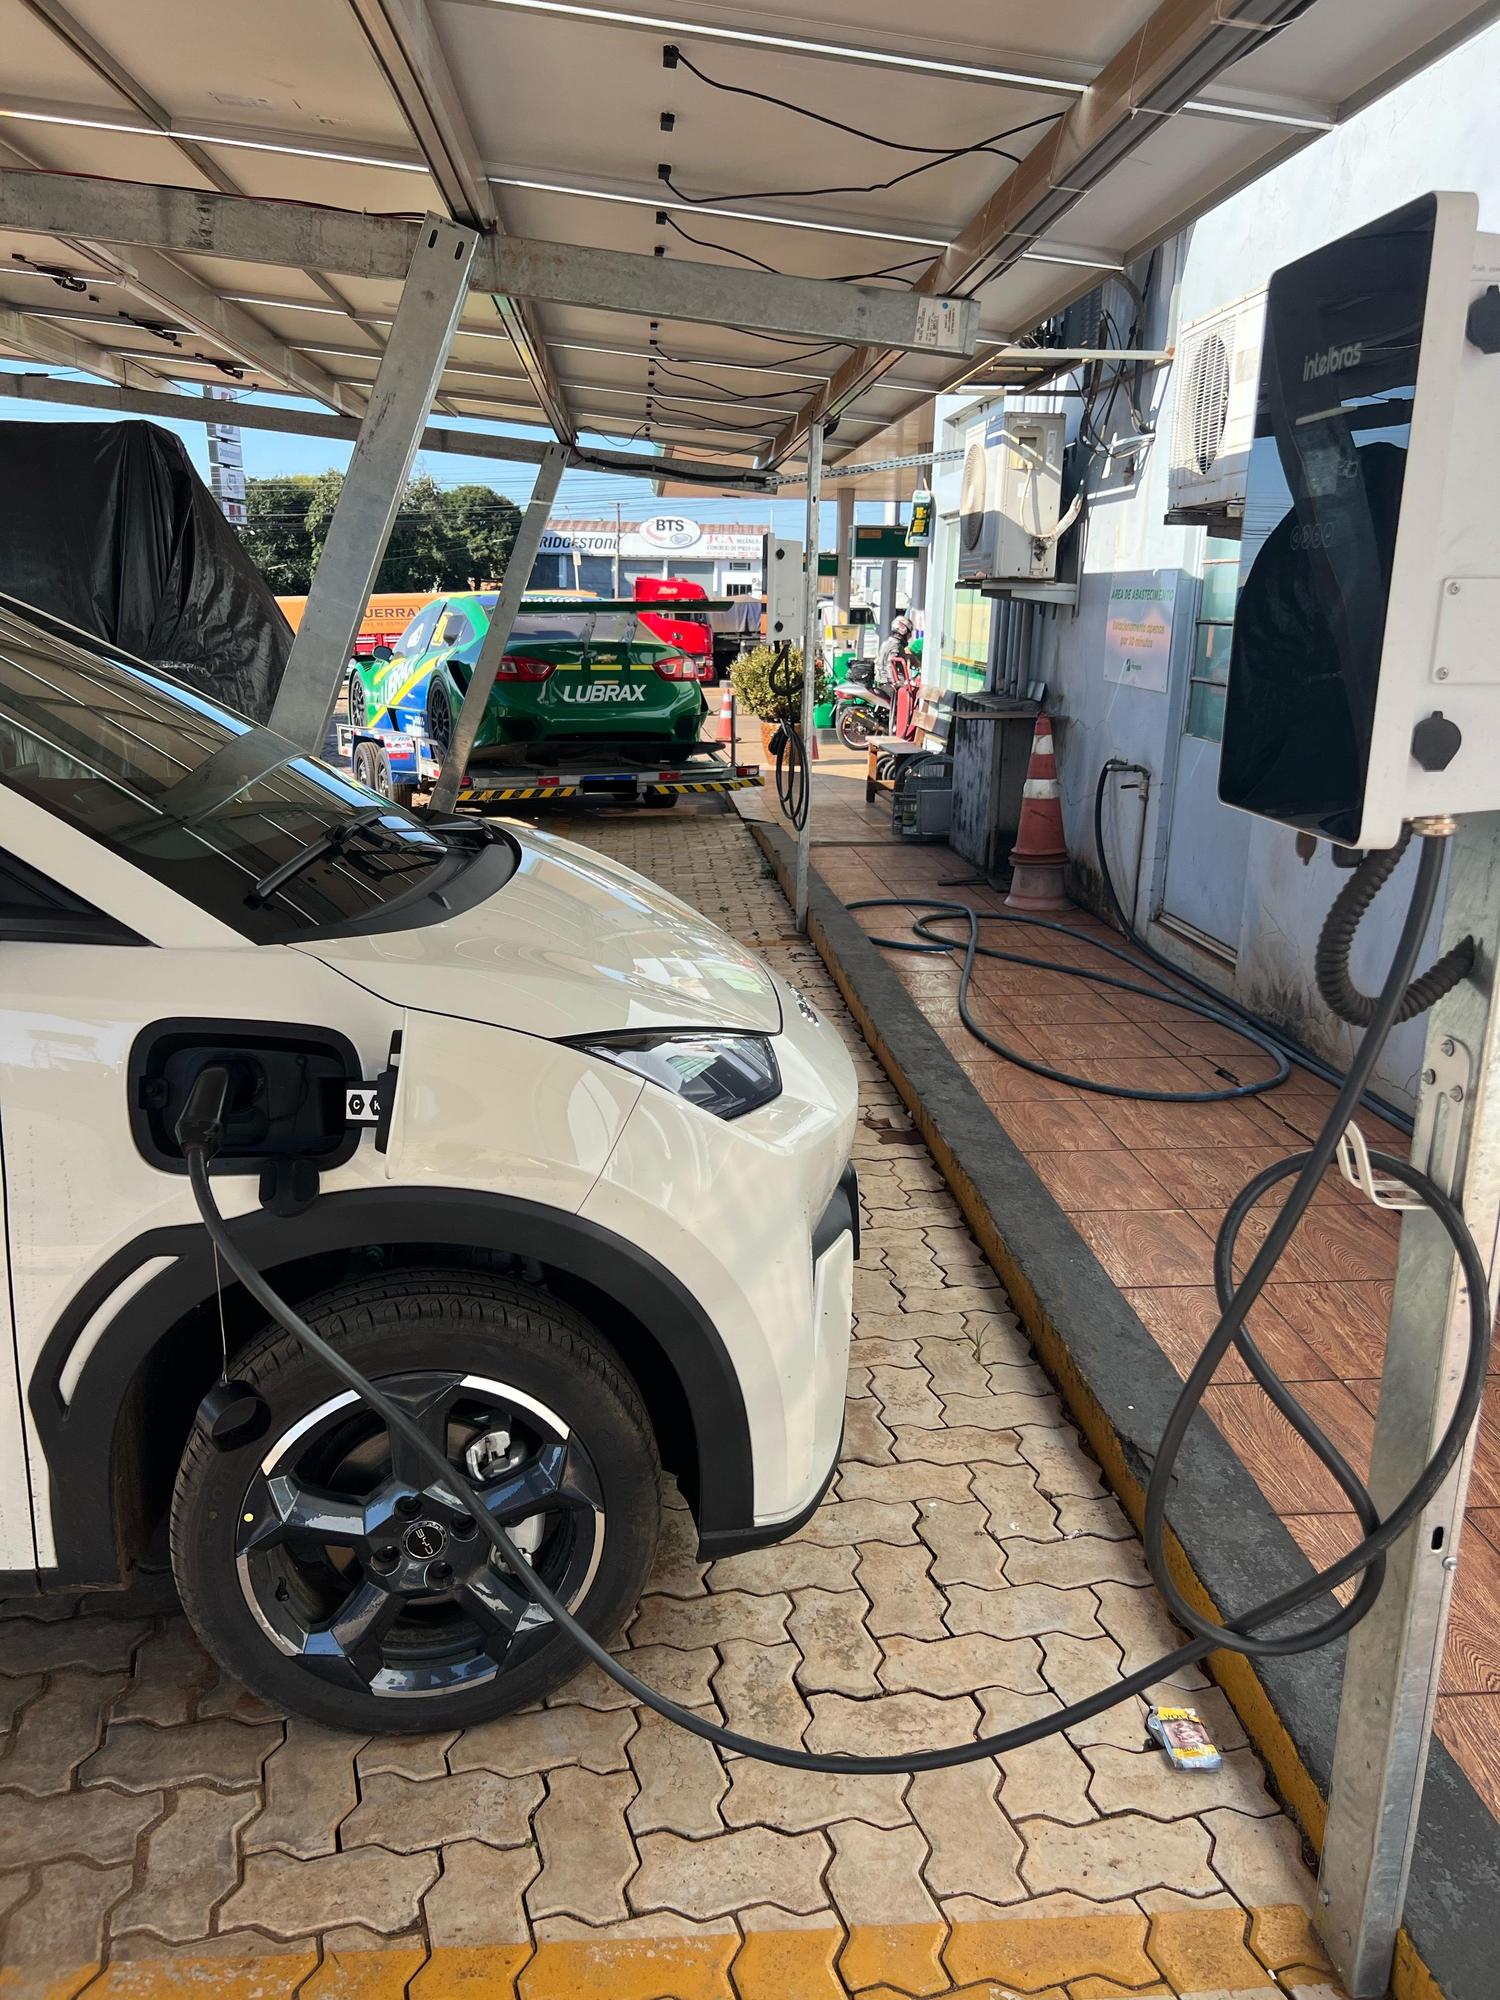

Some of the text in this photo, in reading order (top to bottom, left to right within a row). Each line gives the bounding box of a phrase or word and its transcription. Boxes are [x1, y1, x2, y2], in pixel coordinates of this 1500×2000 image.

[1303, 342, 1362, 382] intelbras
[656, 519, 684, 532] BTS
[365, 608, 416, 618] UERRA
[563, 684, 647, 702] LUBRAX
[353, 1100, 360, 1110] C
[416, 1528, 433, 1554] BYD
